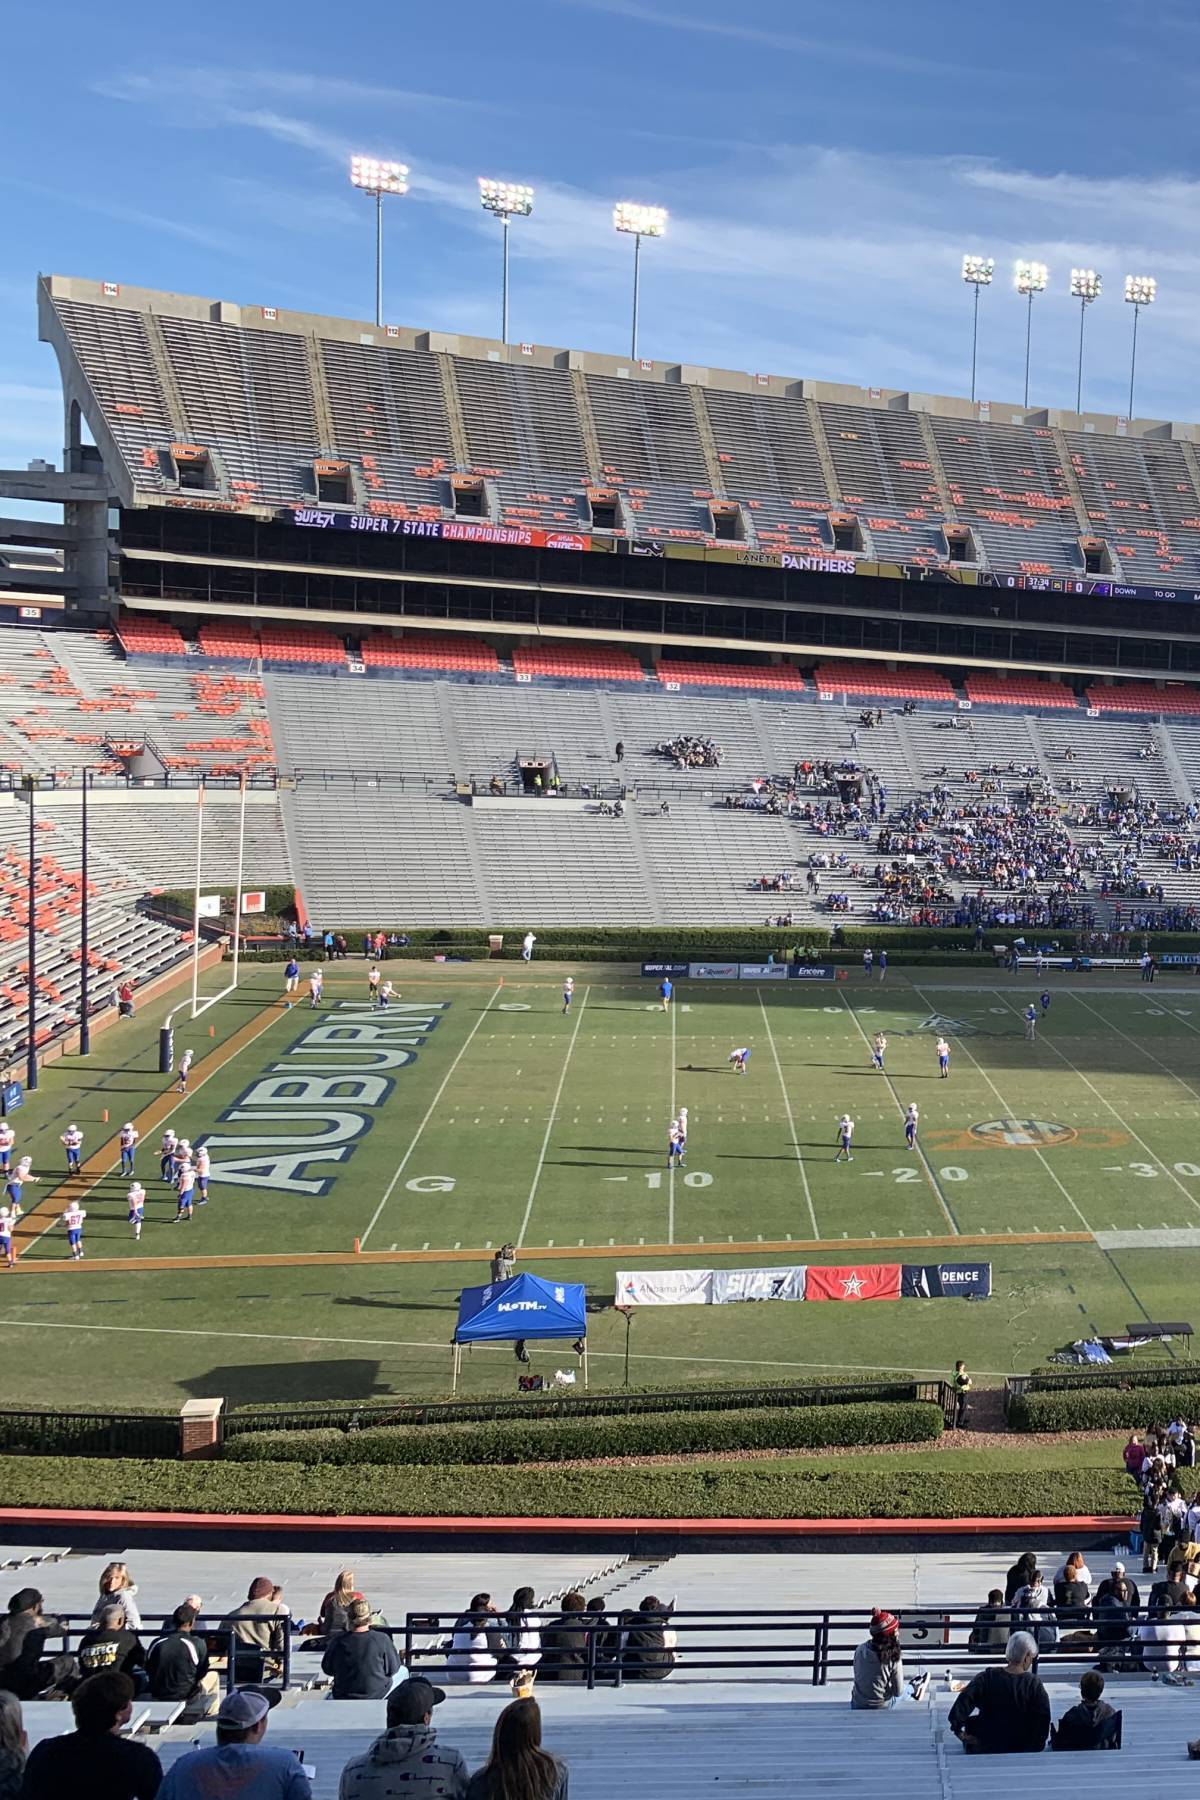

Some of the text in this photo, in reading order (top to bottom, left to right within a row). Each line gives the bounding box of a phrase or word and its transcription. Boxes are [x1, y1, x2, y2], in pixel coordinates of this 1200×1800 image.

[351, 516, 532, 545] SUPER 7 STATE CHAMPIONSHIPS
[736, 553, 856, 574] LANETT PANTHERS
[1007, 577, 1015, 587] 0
[1028, 577, 1049, 587] 37:34
[1075, 582, 1083, 593] 0
[1114, 587, 1136, 596] DOWN
[1154, 590, 1176, 599] TO GO
[193, 1001, 451, 1196] AUBURN
[644, 1171, 714, 1189] 10
[891, 1166, 969, 1183] 20
[405, 1175, 456, 1192] G
[941, 1271, 979, 1281] DENCE
[639, 1283, 704, 1294] Alabama Pow
[912, 1620, 928, 1639] 3
